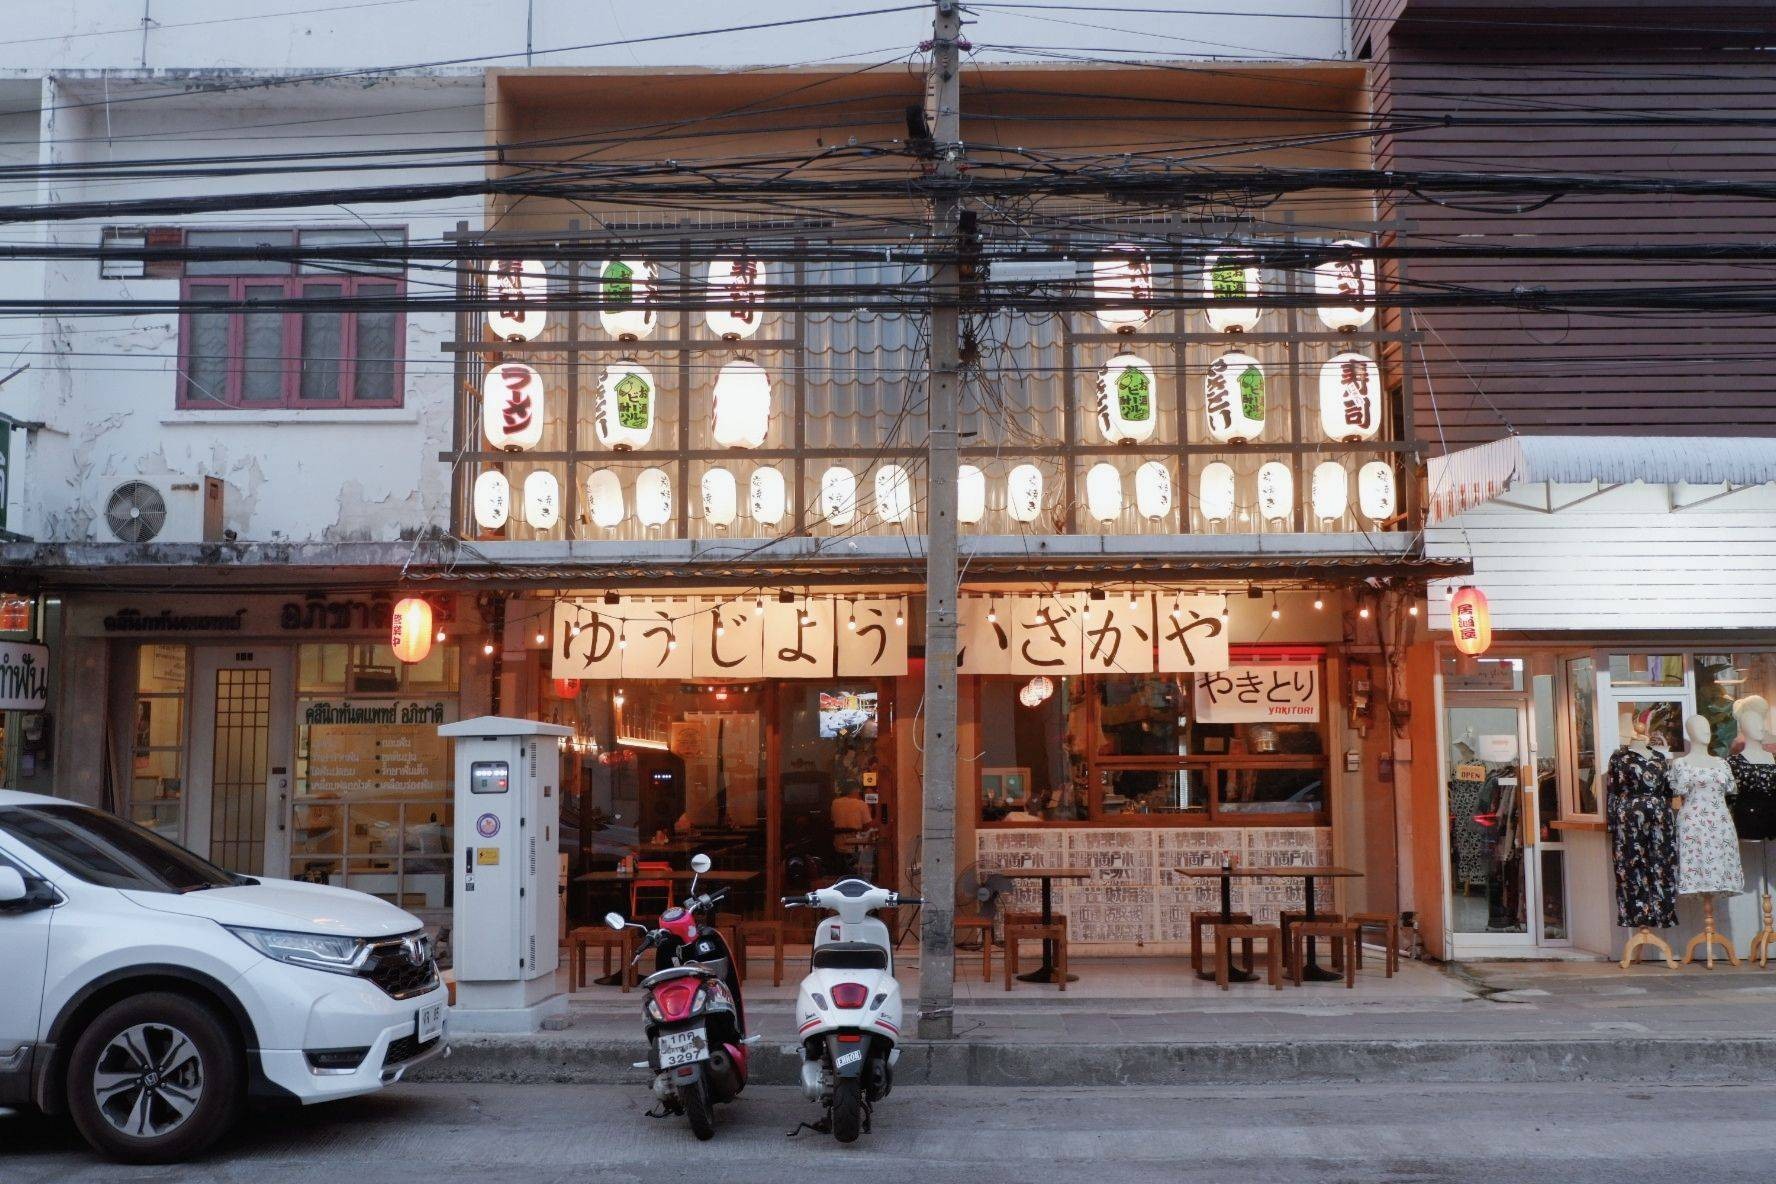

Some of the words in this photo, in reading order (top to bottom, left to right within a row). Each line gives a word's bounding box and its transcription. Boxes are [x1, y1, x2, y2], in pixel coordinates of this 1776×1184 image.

[502, 367, 532, 435] ラーメン
[1207, 359, 1232, 431] やきとり
[1341, 360, 1371, 429] 寿司
[563, 608, 888, 670] ゆうじょう
[1198, 671, 1314, 704] やきとり
[402, 702, 444, 724] อภิชาติ
[1268, 706, 1314, 715] YAKITORI
[1461, 770, 1480, 779] OPEN
[668, 1050, 701, 1065] 3297
